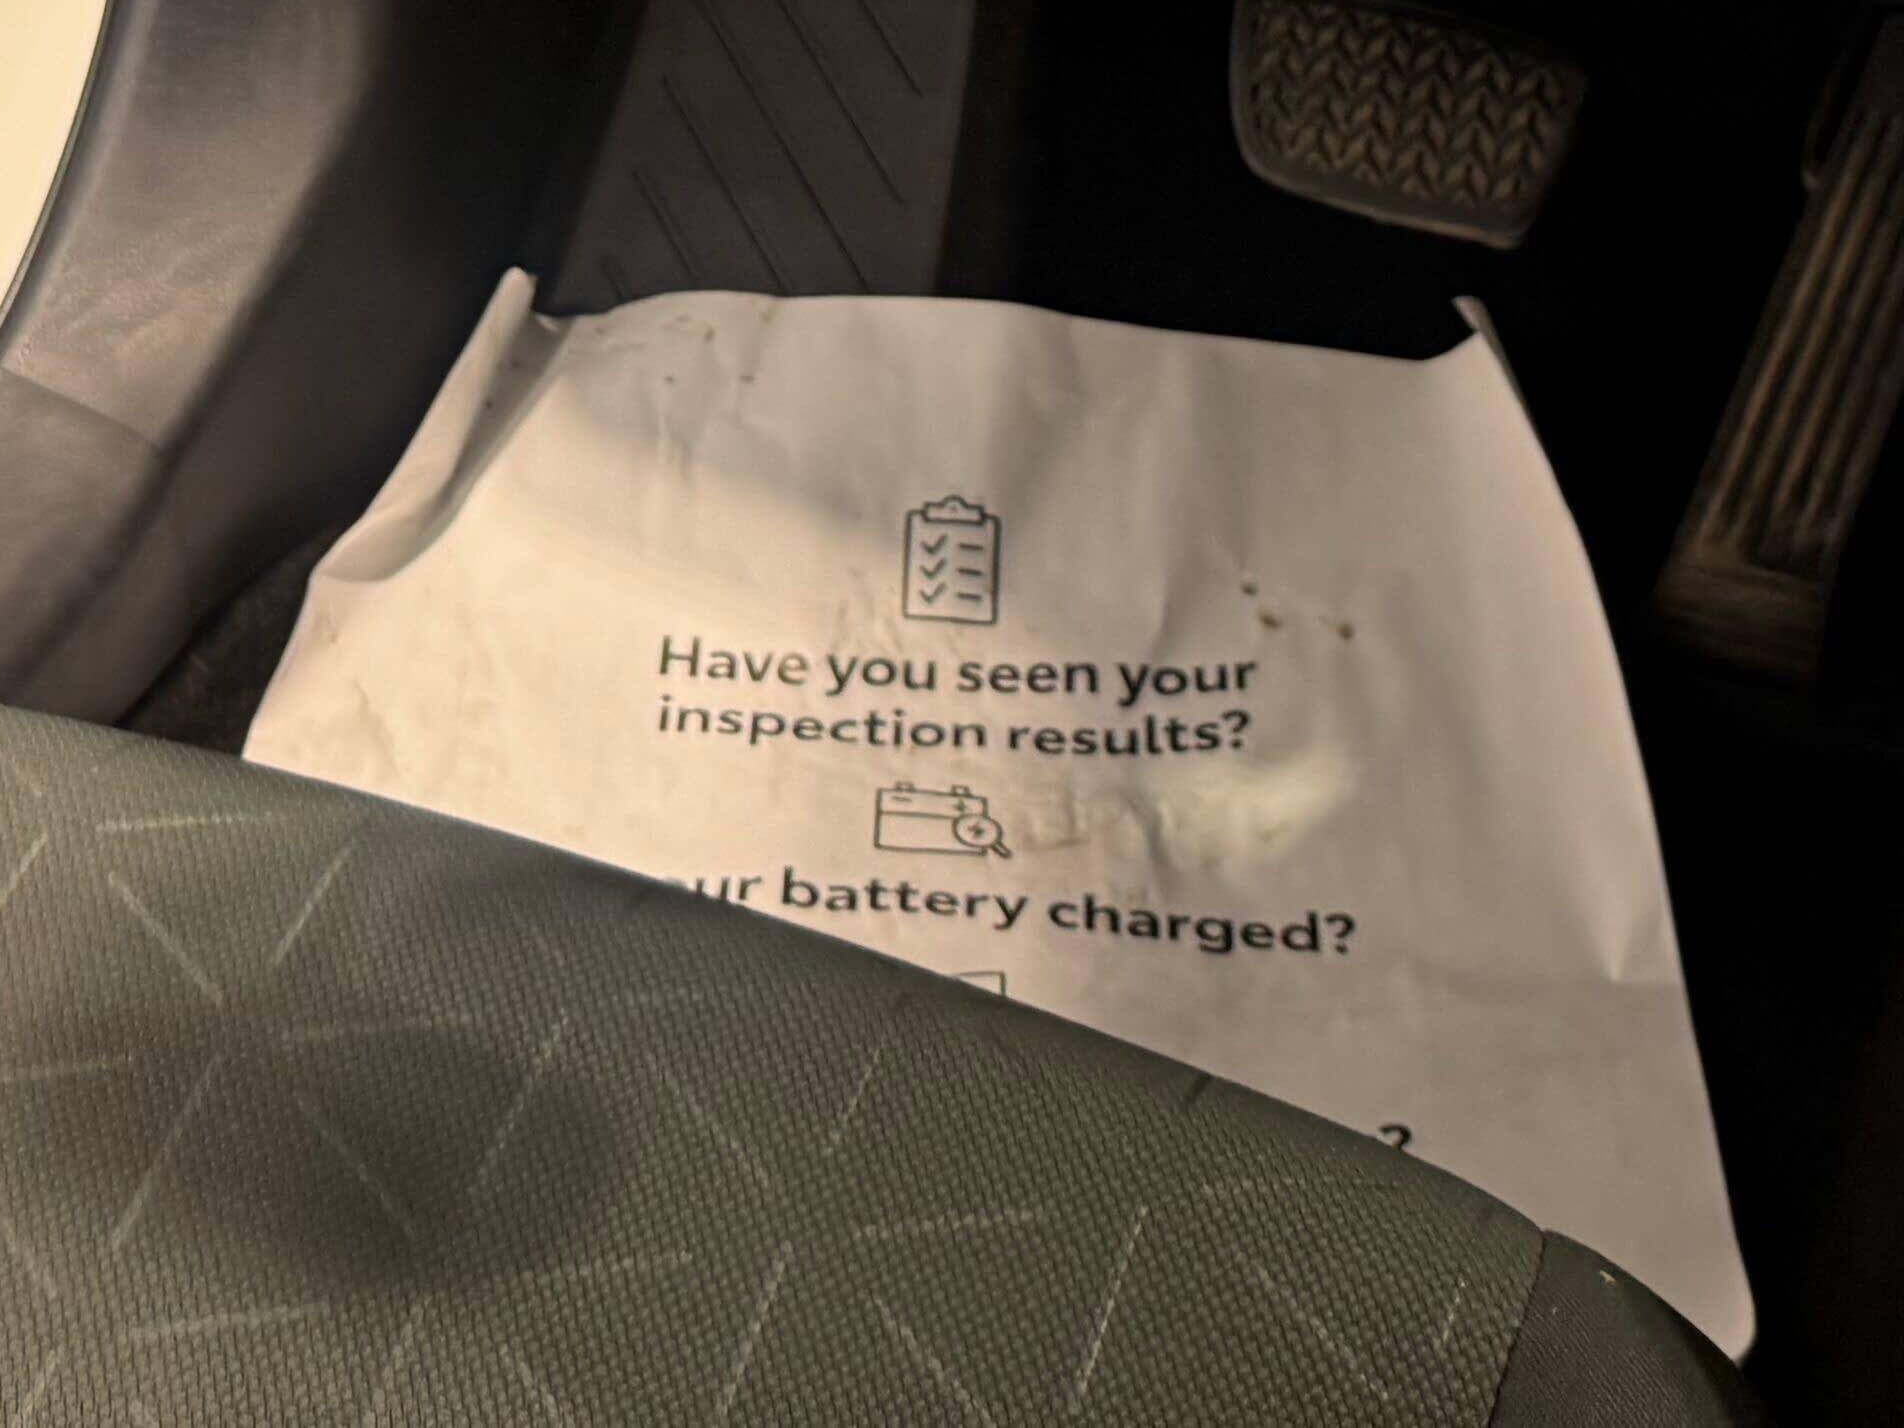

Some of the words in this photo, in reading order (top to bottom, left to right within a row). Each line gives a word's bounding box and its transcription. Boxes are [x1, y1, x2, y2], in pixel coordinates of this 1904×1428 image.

[658, 635, 811, 690] Have
[825, 653, 937, 697] you
[956, 658, 1100, 697] seen
[1116, 657, 1259, 707] your
[657, 694, 989, 750] inspection
[1007, 709, 1252, 757] results?
[779, 866, 1028, 931] battery
[1048, 892, 1357, 956] charged?
